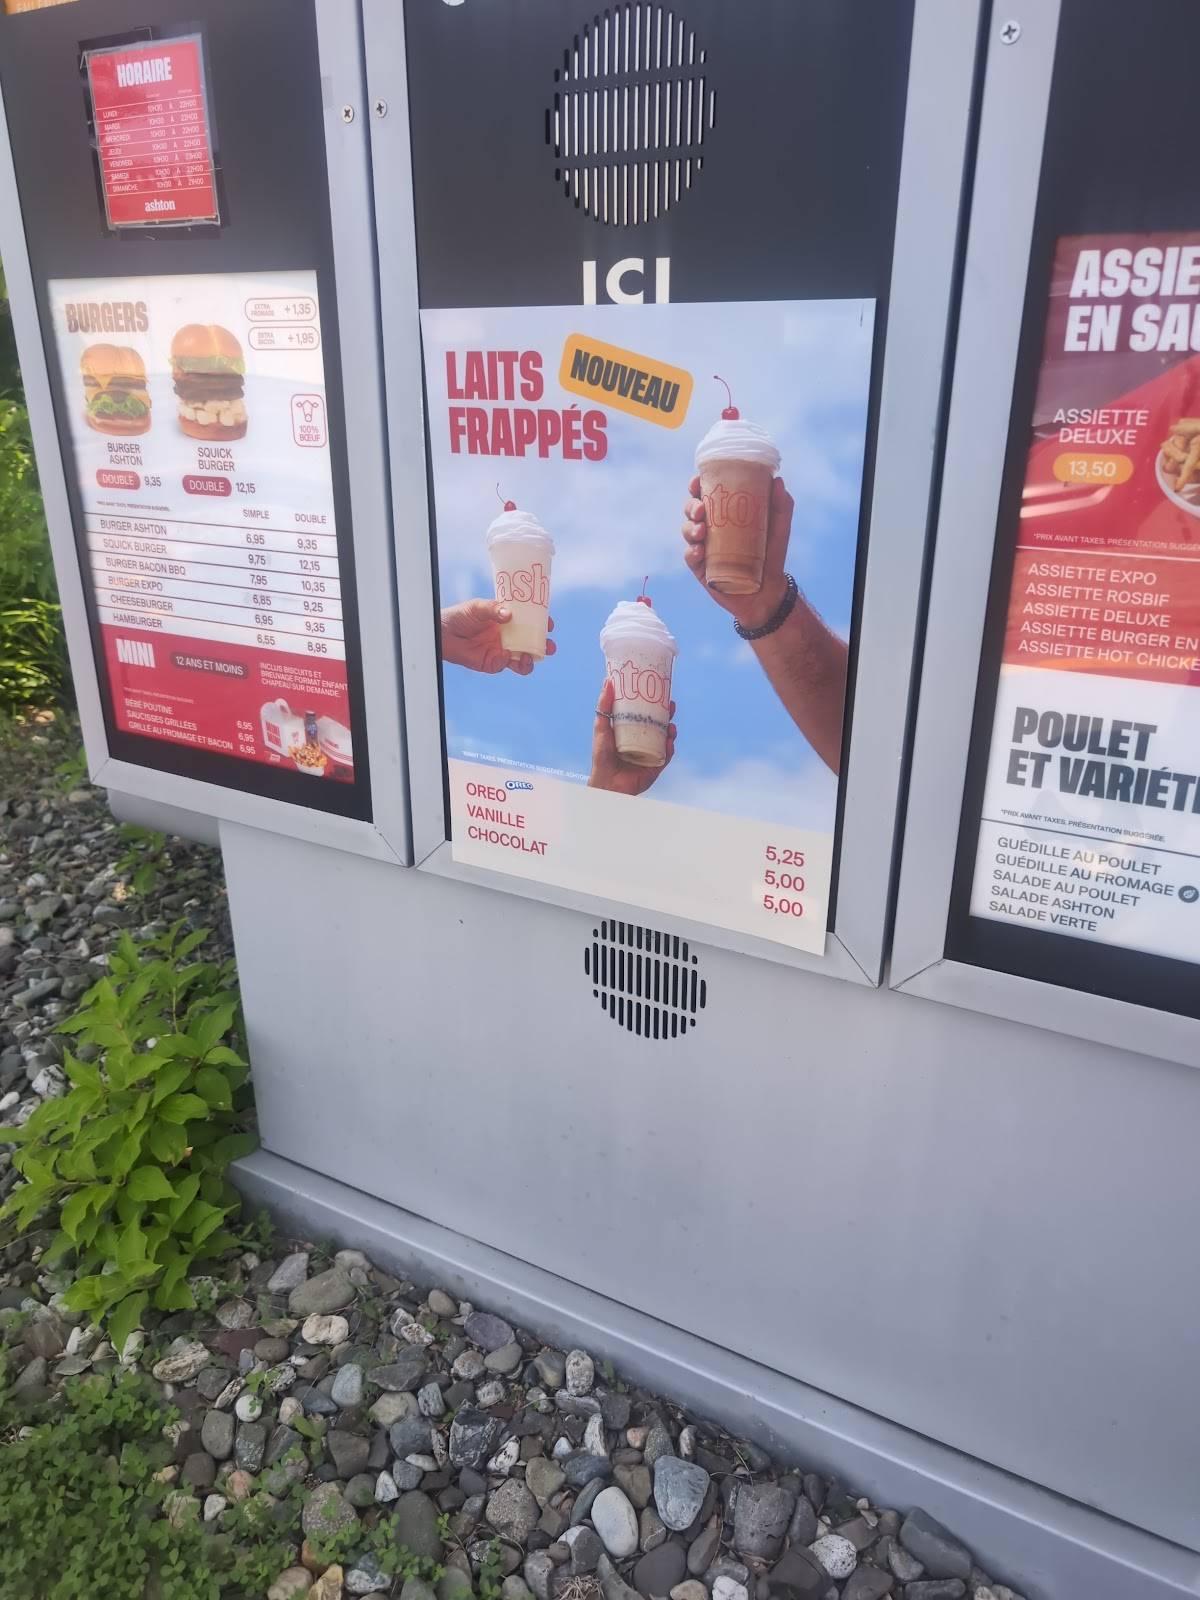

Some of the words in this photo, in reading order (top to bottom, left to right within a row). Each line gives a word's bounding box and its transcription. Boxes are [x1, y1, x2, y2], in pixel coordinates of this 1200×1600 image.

[117, 57, 172, 88] HORAIRE
[113, 184, 139, 193] DIMANCHE
[144, 198, 176, 212] ashton
[583, 257, 670, 305] ICI
[64, 301, 149, 334] BURGERS
[1064, 304, 1122, 352] EN
[445, 350, 544, 402] LAITS
[570, 348, 680, 414] NOUVEAU
[299, 425, 320, 433] 100%
[1053, 408, 1149, 426] ASSIETTE
[448, 403, 608, 462] FRAPPÉS
[1059, 428, 1137, 445] DELUXE
[107, 442, 141, 454] BURGER
[197, 447, 233, 459] SQUICK
[109, 455, 143, 466] ASHTON
[198, 459, 235, 472] BURGER
[1069, 460, 1117, 479] 13,50
[102, 474, 135, 486] DOUBLE
[144, 476, 162, 488] 9,35
[189, 479, 225, 492] DOUBLE
[235, 482, 256, 495] 12,15
[242, 509, 270, 520] SIMPLE
[295, 513, 327, 524] DOUBLE
[100, 519, 132, 532] BURGER
[134, 523, 167, 536] ASHTON
[246, 534, 265, 545] 6,95
[297, 539, 318, 551] 9,35
[1054, 534, 1079, 543] AVANT
[1107, 537, 1168, 549] PRÉSENTATION
[103, 538, 133, 550] SQUICK
[134, 542, 167, 554] BURGER
[248, 554, 266, 566] 9,75
[299, 560, 321, 571] 12,15
[105, 557, 138, 570] BURGER
[139, 561, 167, 574] BACON
[168, 565, 186, 576] BBQ
[250, 574, 268, 586] 7,95
[301, 580, 326, 593] 10,35
[1028, 563, 1106, 582] ASSIETTE
[1110, 570, 1157, 586] EXPO
[108, 576, 140, 588] BURGER
[141, 580, 163, 592] EXPO
[252, 594, 272, 606] 6,85
[304, 601, 324, 613] 9,25
[1025, 582, 1103, 601] ASSIETTE
[1106, 589, 1170, 607] ROSBIF
[110, 594, 174, 611] CHEESEBURGER
[255, 614, 274, 626] 6,95
[305, 621, 326, 633] 9,35
[1023, 602, 1100, 621] ASSIETTE
[1103, 609, 1171, 628] DELUXE
[112, 613, 162, 628] HAMBURGER
[256, 634, 276, 646] 6,55
[307, 641, 328, 654] 8,95
[1020, 621, 1097, 640] ASSIETTE
[1101, 629, 1170, 647] BURGER
[1174, 636, 1199, 650] EN
[116, 638, 156, 668] MINI
[1018, 639, 1095, 659] ASSIETTE
[1098, 648, 1133, 663] HOT
[176, 656, 184, 666] 12
[186, 658, 203, 669] ANS
[204, 661, 214, 670] ET
[215, 662, 244, 676] MOINS
[260, 662, 283, 672] INCLUS
[283, 665, 313, 678] BISCUITS
[313, 671, 322, 679] ET
[261, 671, 294, 682] BREUVAGE
[294, 675, 321, 686] FORMAT
[262, 678, 292, 689] CHAPEAU
[292, 682, 306, 691] SUR
[126, 710, 163, 725] SAUCISSES
[143, 702, 173, 715] POUTINE
[152, 726, 162, 735] AU
[162, 727, 197, 742] FROMAGE
[197, 735, 207, 744] ET
[207, 737, 233, 750] BACON
[1011, 706, 1158, 762] POULET
[1005, 748, 1052, 789] ET
[466, 782, 507, 802] OREO
[505, 780, 534, 791] OREO
[466, 802, 525, 829] VANILLE
[1020, 812, 1043, 821] AVANT
[1068, 819, 1123, 836] PRÉSENTATION
[467, 825, 548, 857] CHOCOLAT
[765, 844, 805, 868] 5,25
[997, 836, 1071, 859] GUÉDILLE
[1072, 850, 1095, 864] AU
[1098, 855, 1162, 876] POULET
[764, 869, 805, 893] 5,00
[995, 853, 1068, 876] GUÉDILLE
[1070, 867, 1091, 881] AU
[1095, 872, 1175, 897] FROMAGE
[993, 869, 1051, 890] SALADE
[1054, 882, 1075, 894] AU
[1078, 886, 1141, 907] POULET
[762, 894, 804, 918] 5,00
[991, 885, 1049, 906] SALADE
[1051, 897, 1115, 919] ASHTON
[989, 901, 1047, 922] SALADE
[1050, 913, 1098, 932] VERTE
